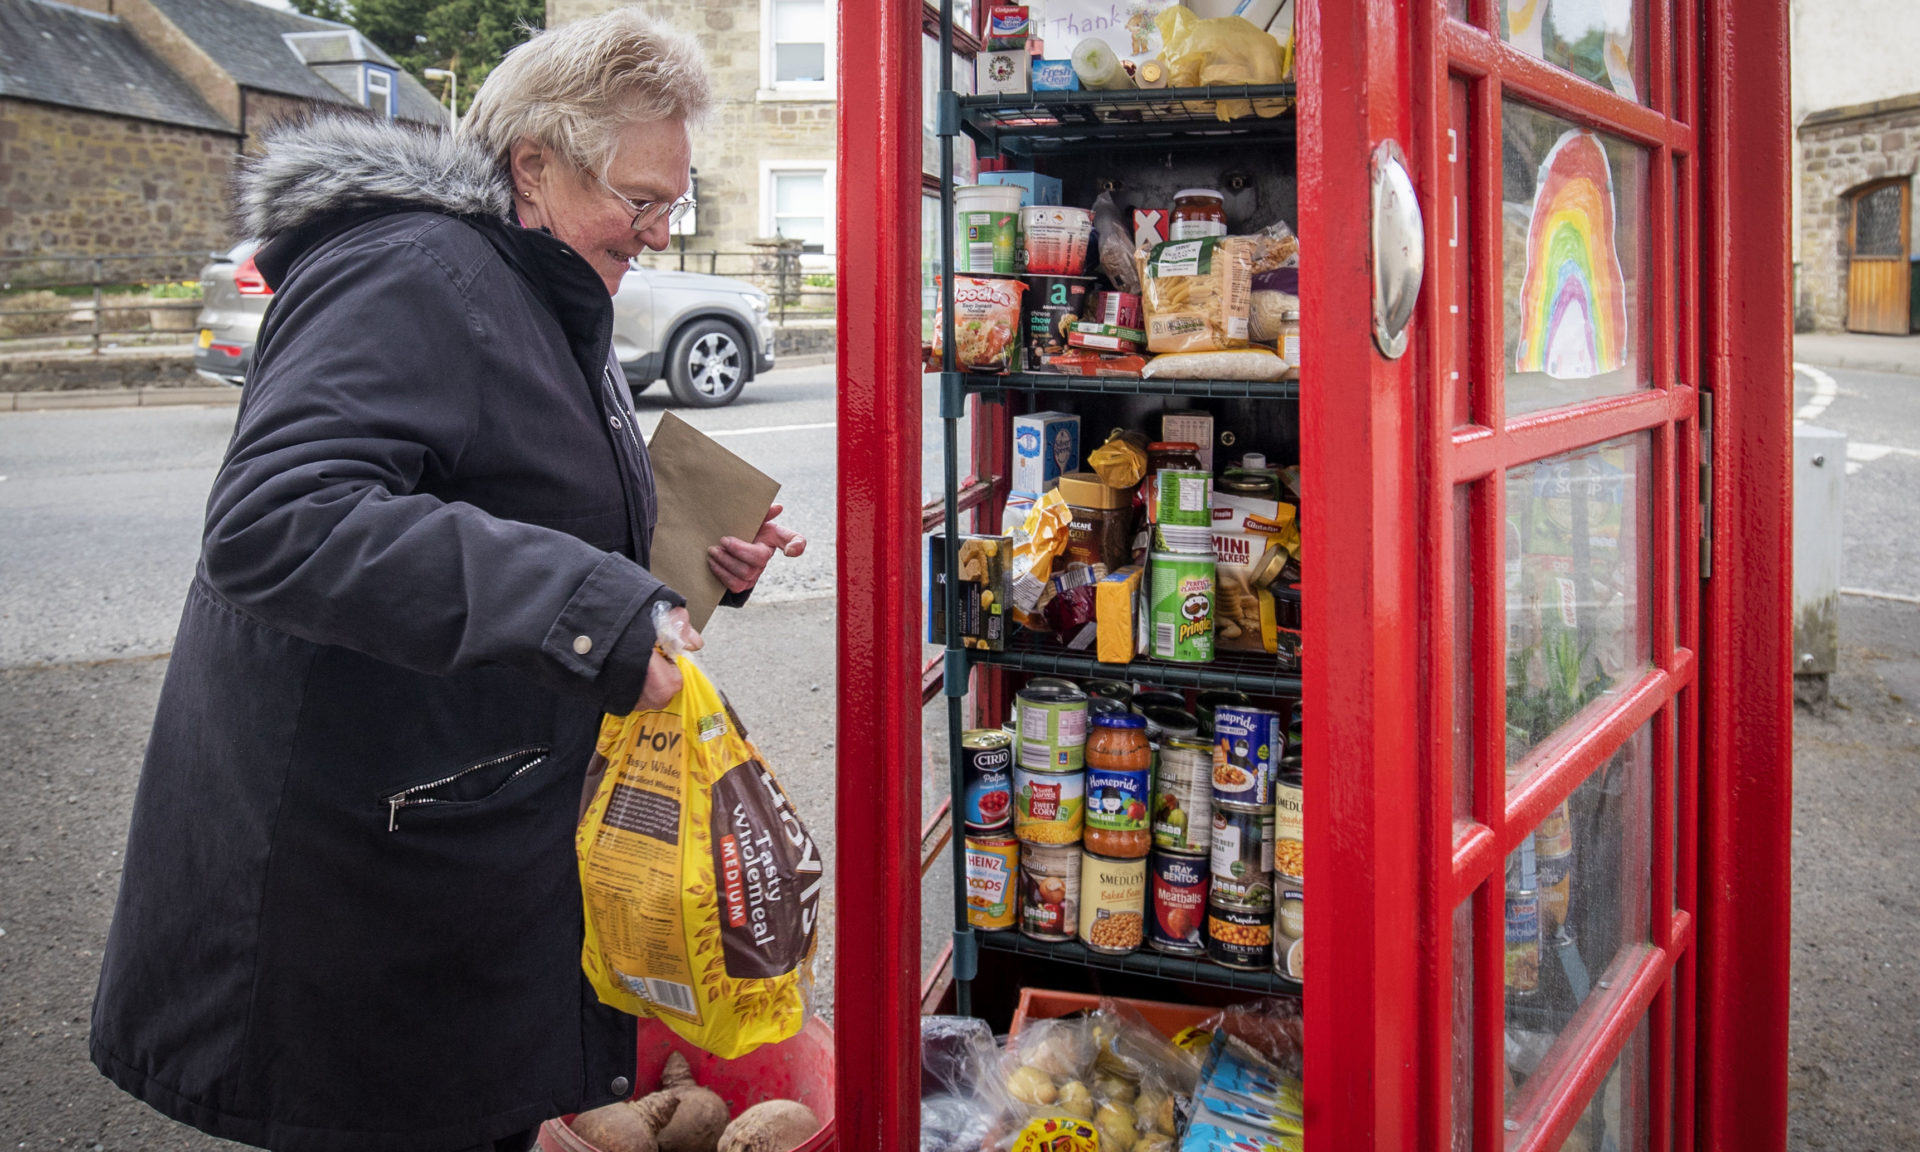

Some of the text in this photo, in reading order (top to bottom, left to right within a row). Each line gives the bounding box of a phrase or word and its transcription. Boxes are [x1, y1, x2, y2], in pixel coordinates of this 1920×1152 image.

[1050, 4, 1121, 39] Thank
[1041, 64, 1072, 76] Fresh
[1046, 75, 1071, 84] Clean
[1031, 316, 1051, 324] chow
[1031, 324, 1049, 332] mein
[1211, 535, 1250, 555] MINI
[1217, 552, 1250, 565] ACKERS
[978, 752, 1008, 766] CIRIO
[1089, 773, 1137, 792] Homepride
[1033, 801, 1055, 810] SWEET
[1032, 808, 1056, 817] CORN
[755, 829, 782, 901] Tasty
[968, 855, 1001, 871] HEINZ
[1169, 864, 1193, 875] FRAY
[733, 802, 776, 947] Wholemeal
[1163, 871, 1199, 884] BENTOS
[722, 842, 744, 921] MEDIUM
[1101, 889, 1124, 901] Baked
[1158, 888, 1202, 905] Meatballs
[1222, 942, 1264, 953] CHICK PEAS
